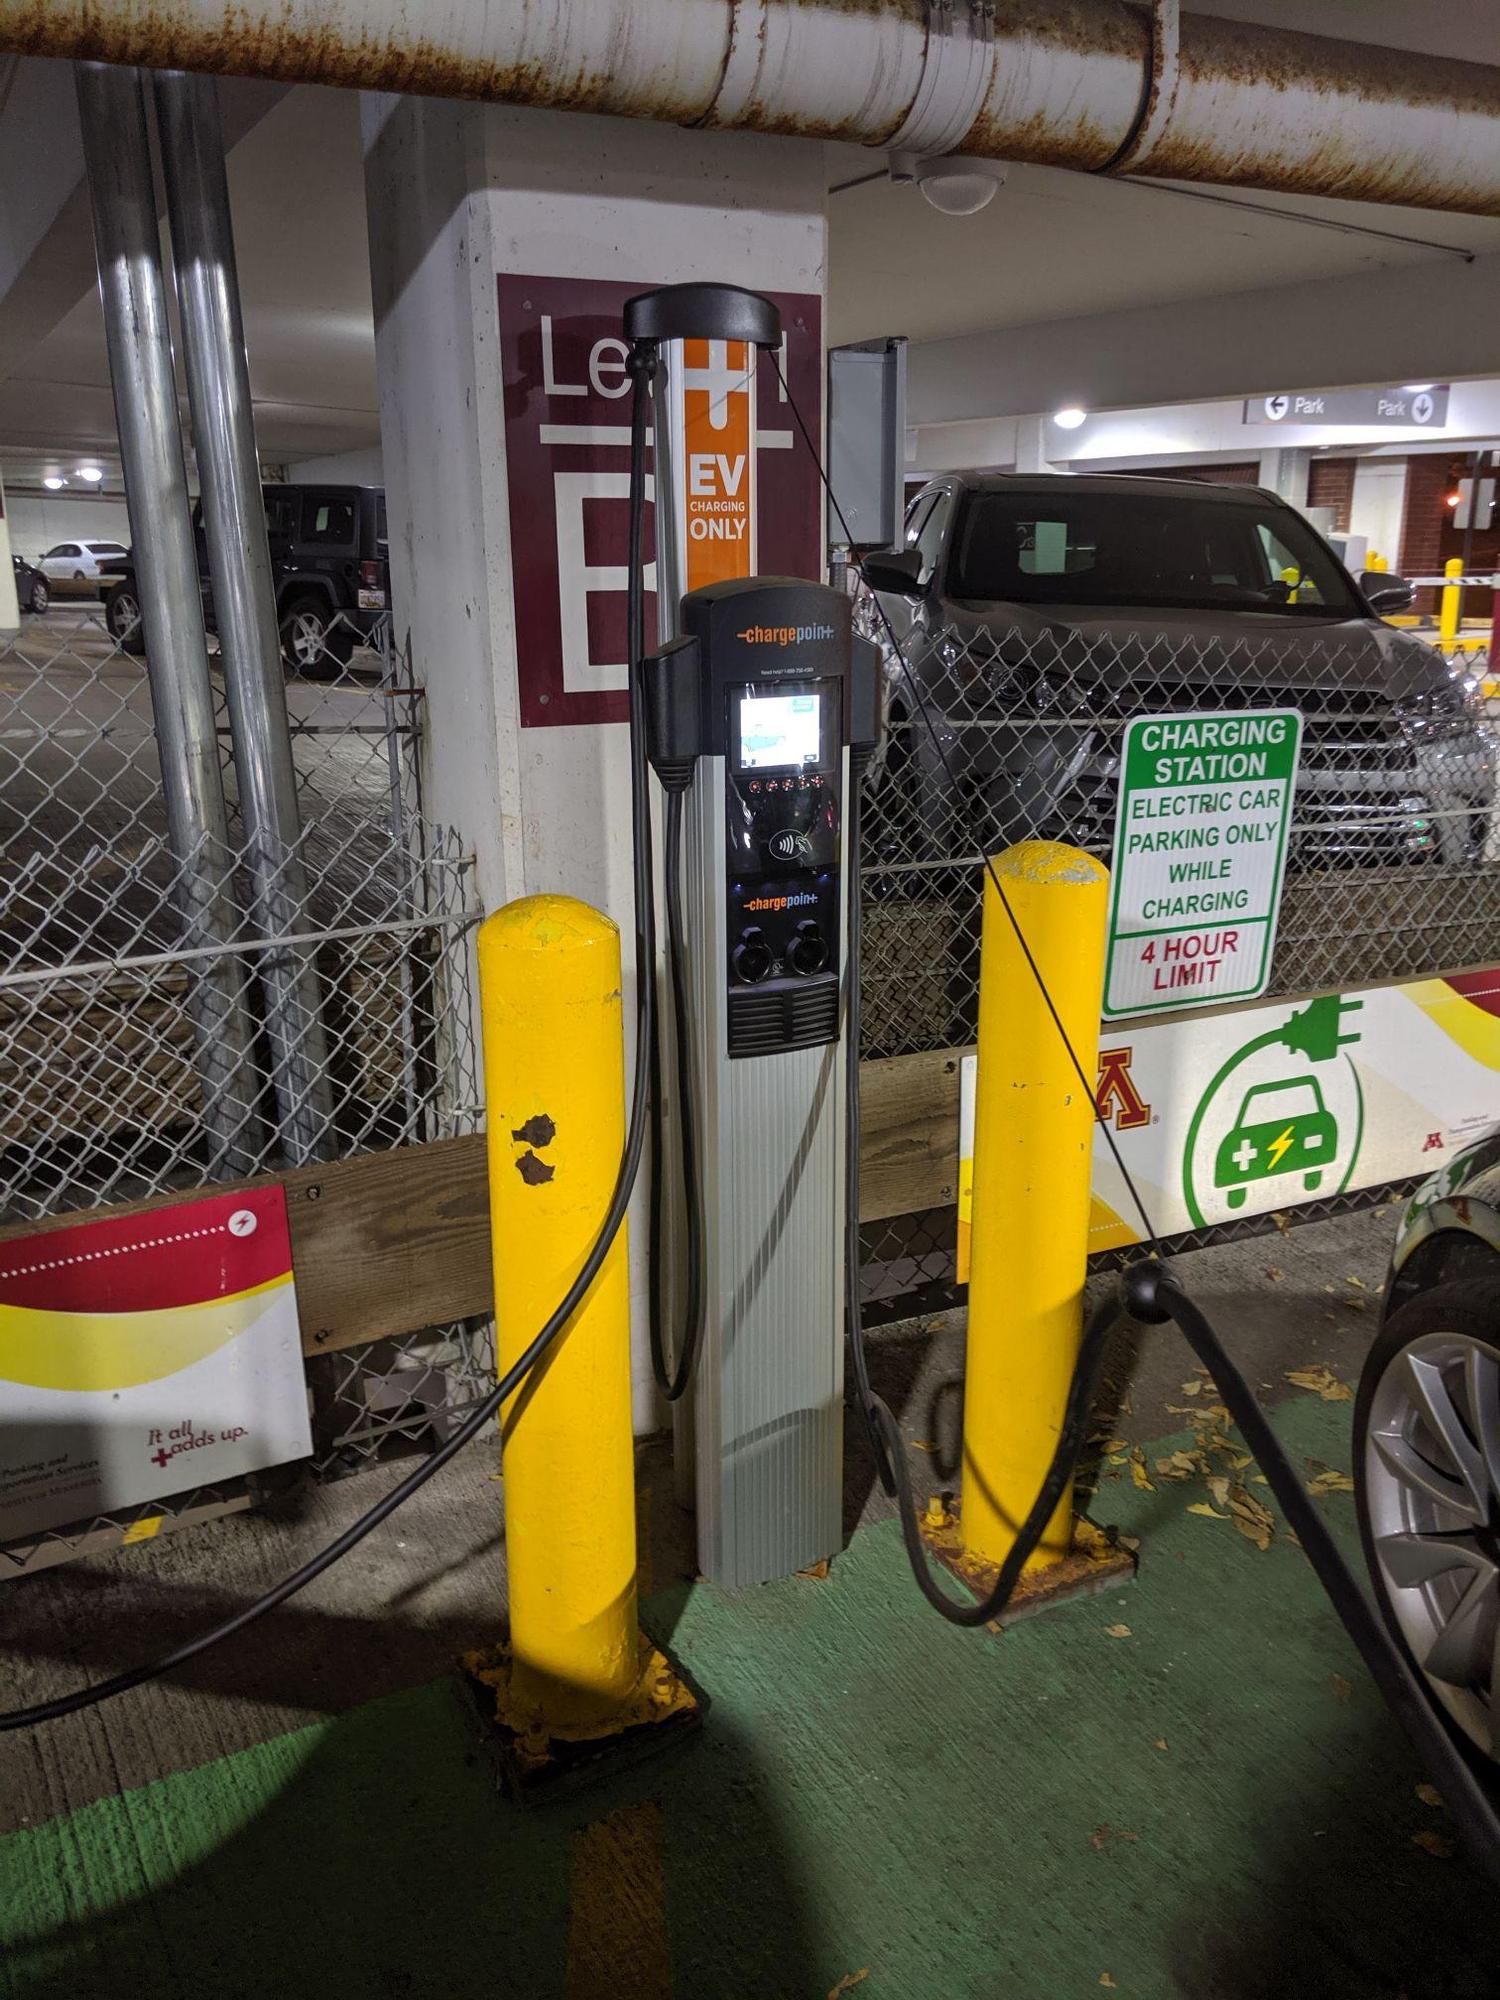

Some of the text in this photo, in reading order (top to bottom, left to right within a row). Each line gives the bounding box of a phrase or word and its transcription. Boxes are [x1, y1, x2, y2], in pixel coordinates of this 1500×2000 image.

[1294, 398, 1325, 415] Park
[1377, 400, 1406, 417] Park
[690, 454, 745, 496] EV
[690, 501, 745, 513] CHARGING
[690, 518, 746, 541] ONLY
[1142, 719, 1286, 751] CHARGING
[1154, 752, 1267, 784] STATION
[1132, 788, 1281, 820] ELECTRIC CAR
[1128, 821, 1278, 854] PARKING ONLY
[1169, 858, 1232, 884] WHILE
[1143, 889, 1248, 920] CHARGING
[1140, 931, 1239, 964] 4 HOUR
[1153, 960, 1221, 991] LIMIT
[148, 1419, 192, 1446] It all
[171, 1429, 216, 1454] adds
